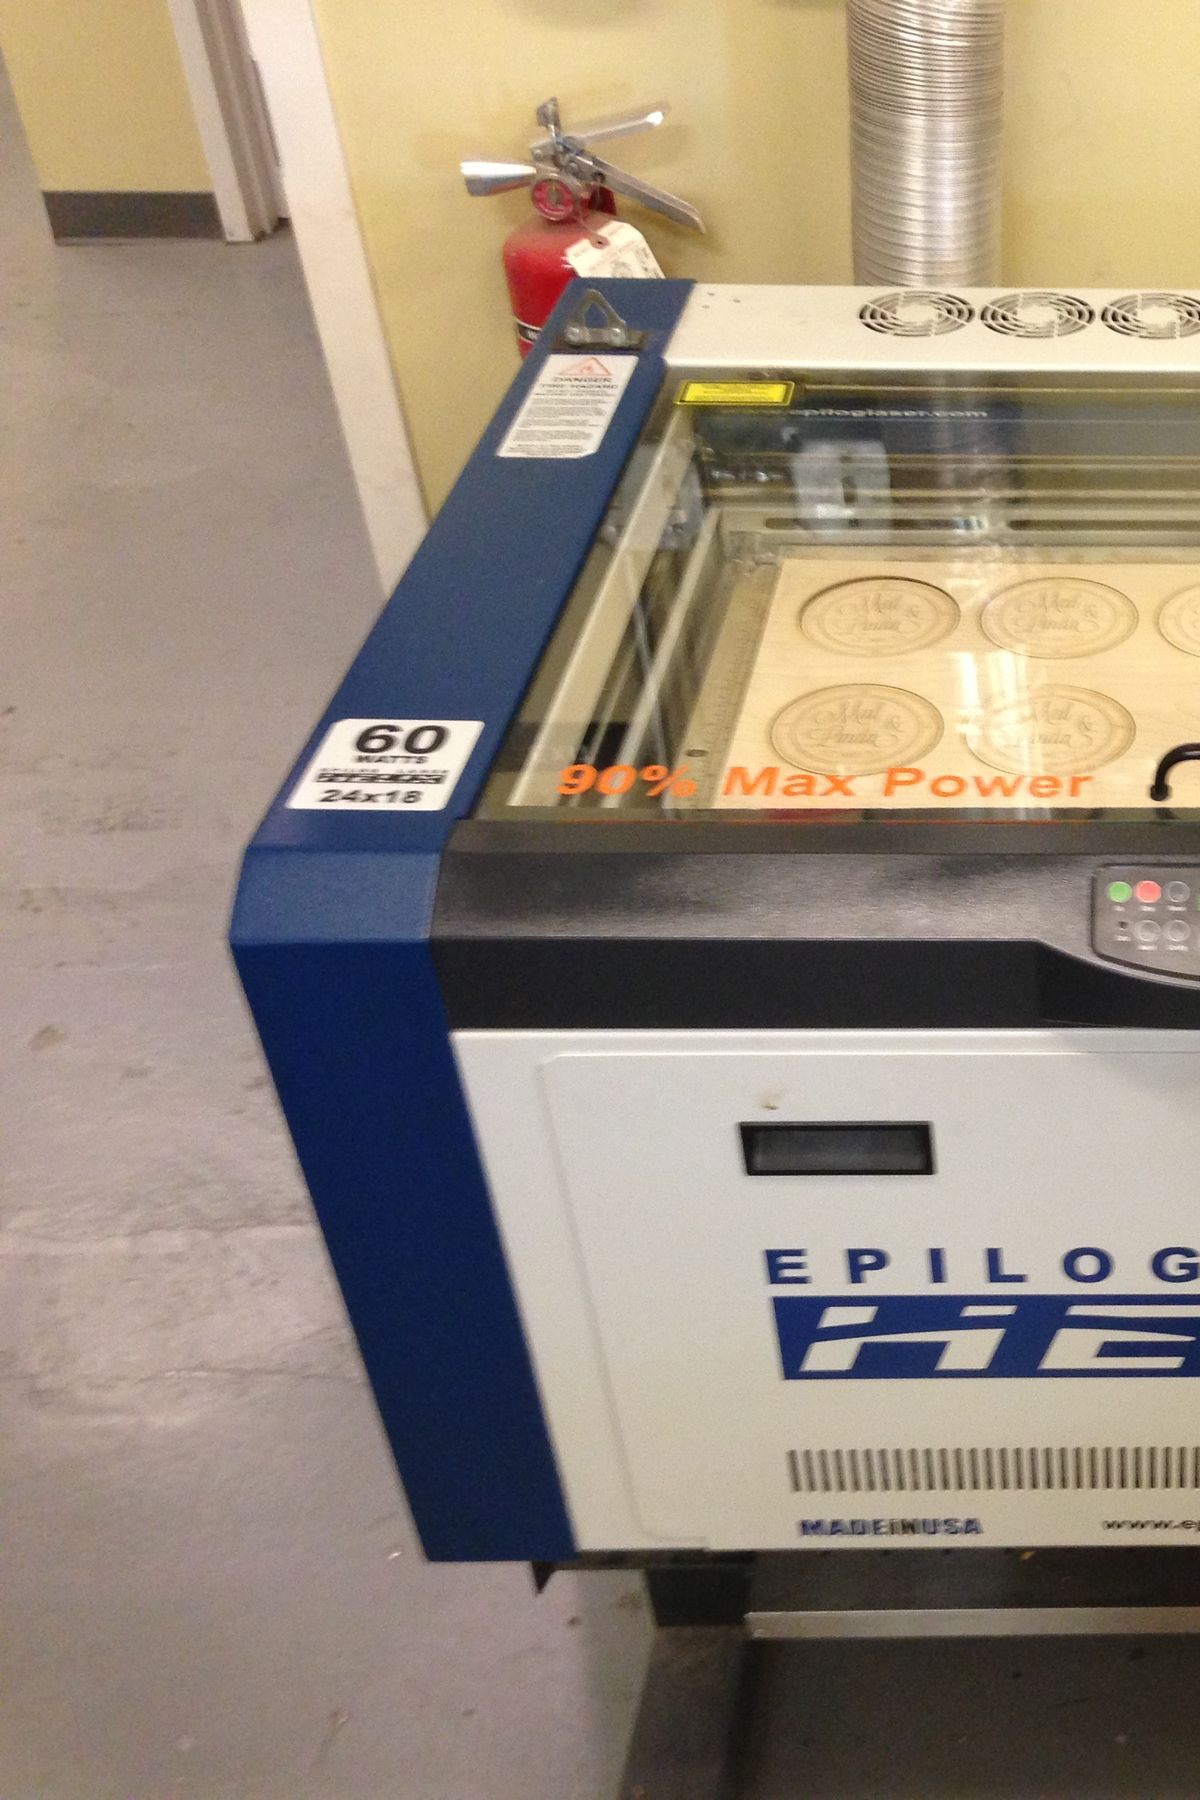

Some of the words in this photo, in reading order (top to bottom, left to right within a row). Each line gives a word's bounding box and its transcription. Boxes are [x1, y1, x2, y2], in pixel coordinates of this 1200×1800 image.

[355, 725, 449, 754] 60
[354, 755, 429, 764] WATTS
[556, 763, 697, 798] 90%
[722, 766, 857, 796] Max
[883, 767, 1095, 797] Power
[319, 789, 423, 804] 24x18
